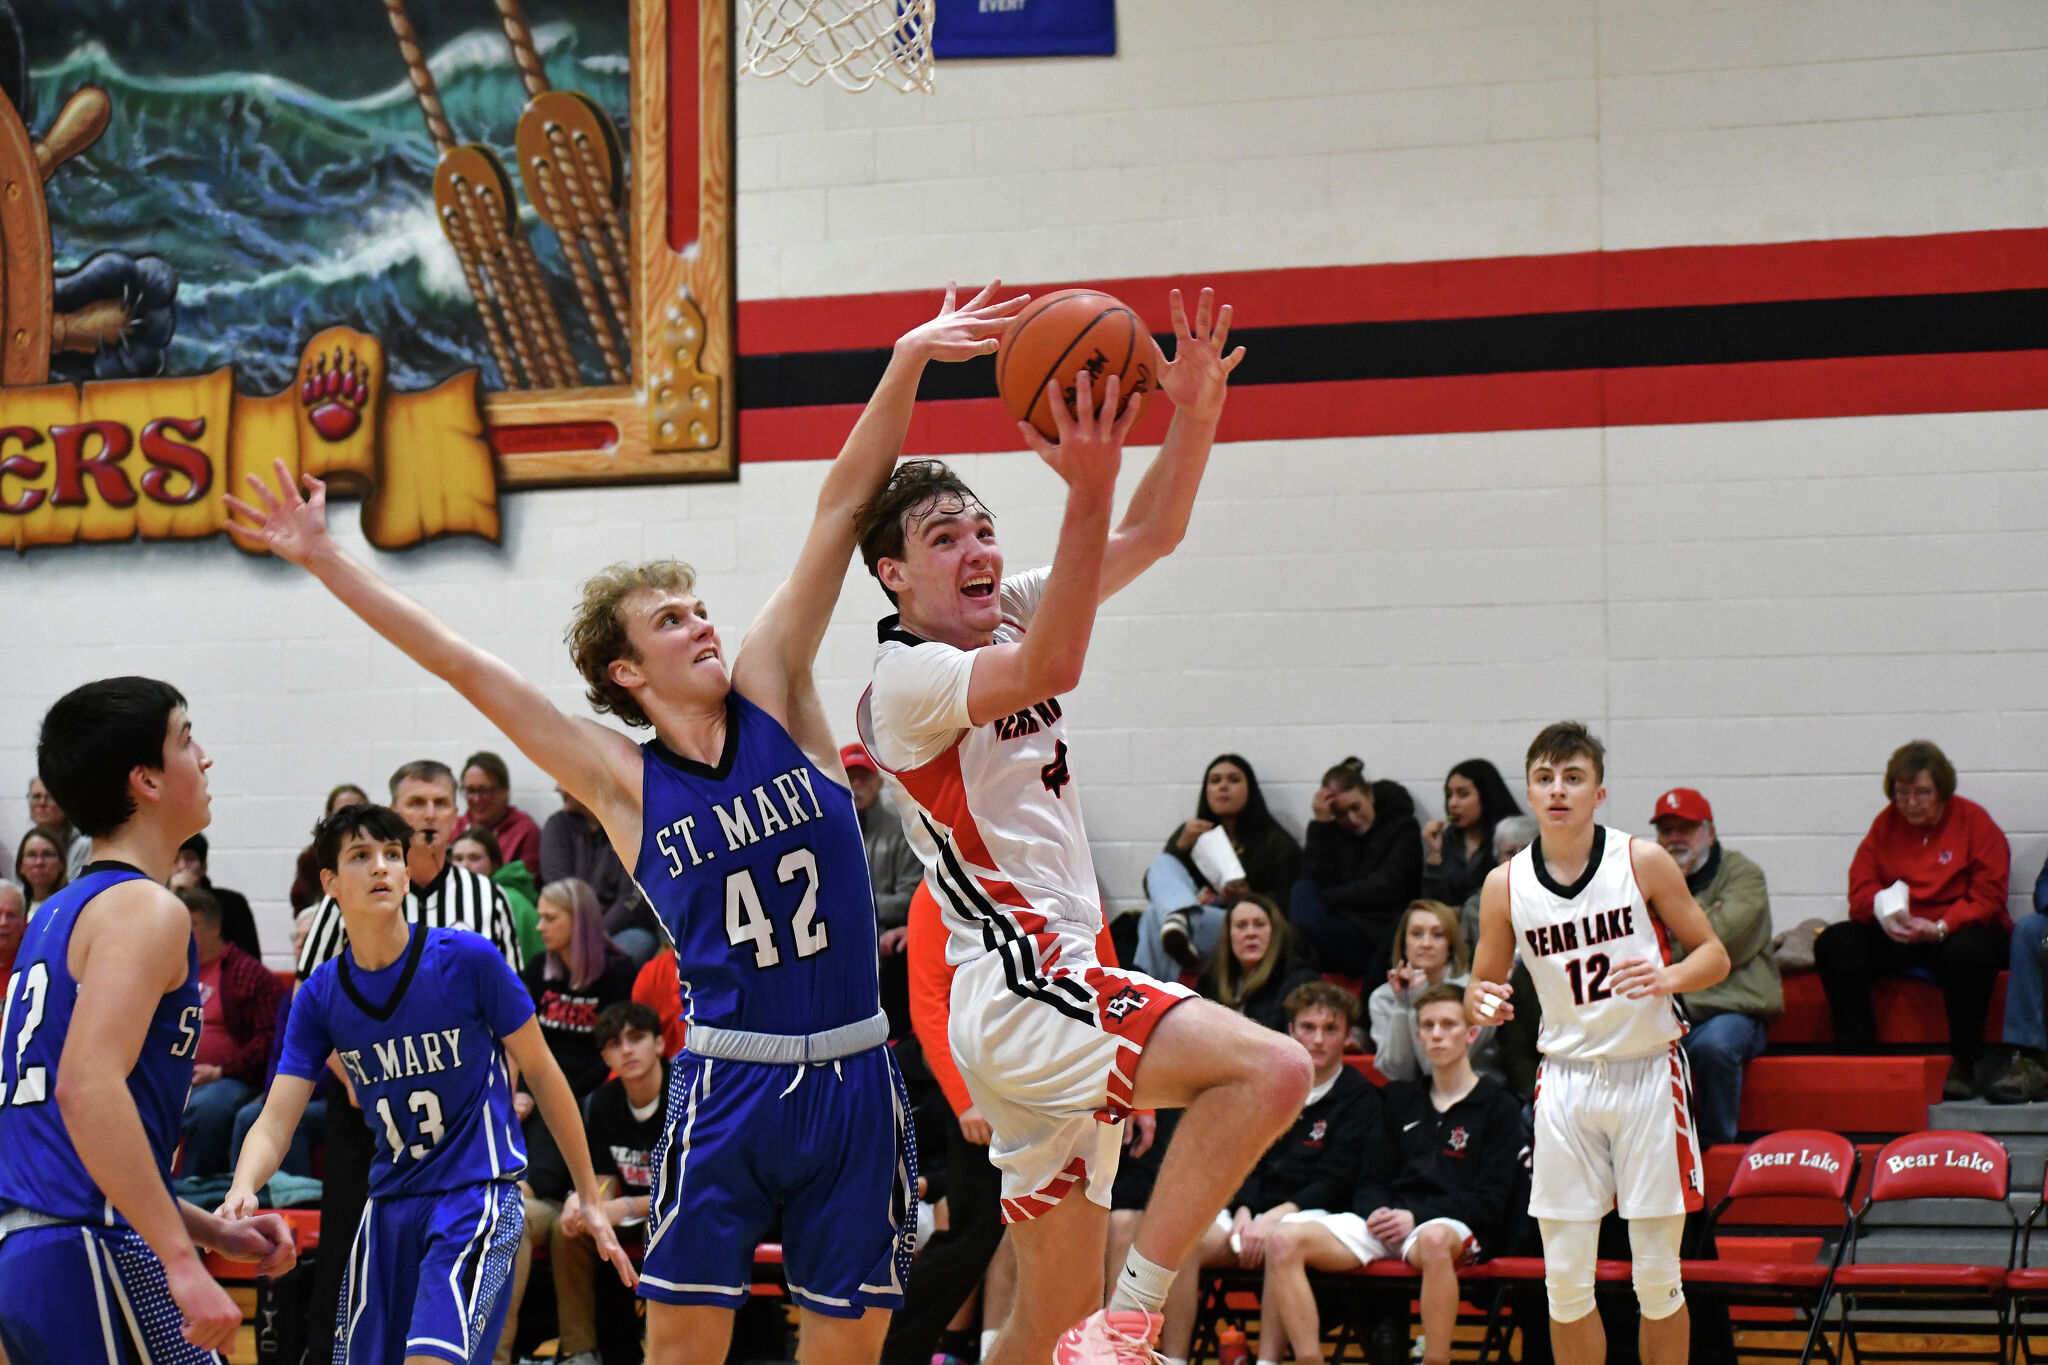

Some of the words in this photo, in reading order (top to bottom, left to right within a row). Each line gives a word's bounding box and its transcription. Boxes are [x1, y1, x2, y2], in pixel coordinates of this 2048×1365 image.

[0, 416, 213, 515] ERS
[656, 815, 716, 879] ST.
[712, 767, 824, 852] MARY
[725, 847, 828, 969] 42
[1525, 921, 1578, 957] BEAR
[1582, 905, 1634, 946] LAKE
[1565, 952, 1612, 1006] 12
[372, 1028, 462, 1082] MARY
[376, 1089, 445, 1164] 13
[1748, 1149, 1795, 1171] Bear
[1800, 1149, 1840, 1175] Lake
[1886, 1152, 1939, 1175] Bear
[1945, 1149, 1994, 1174] Lake
